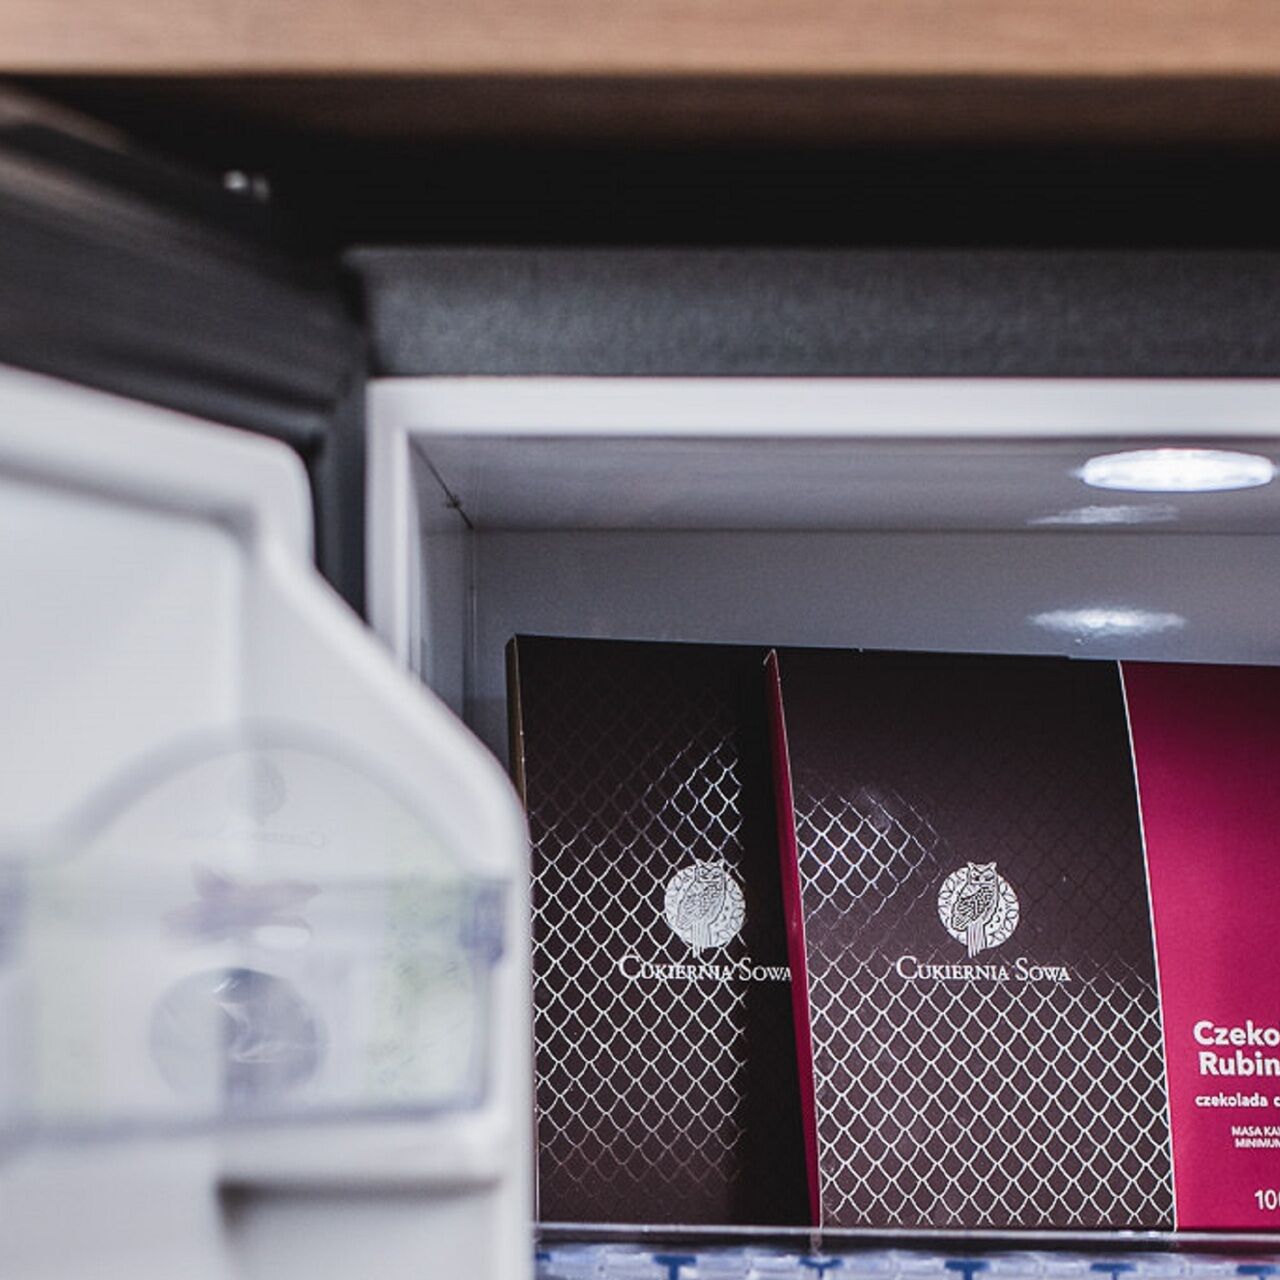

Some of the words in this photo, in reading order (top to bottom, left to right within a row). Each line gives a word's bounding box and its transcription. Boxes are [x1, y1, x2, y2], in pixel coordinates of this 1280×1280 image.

[895, 954, 1010, 982] CUKIERNIA
[1014, 956, 1072, 983] SOWA
[1194, 1091, 1269, 1108] czekolada
